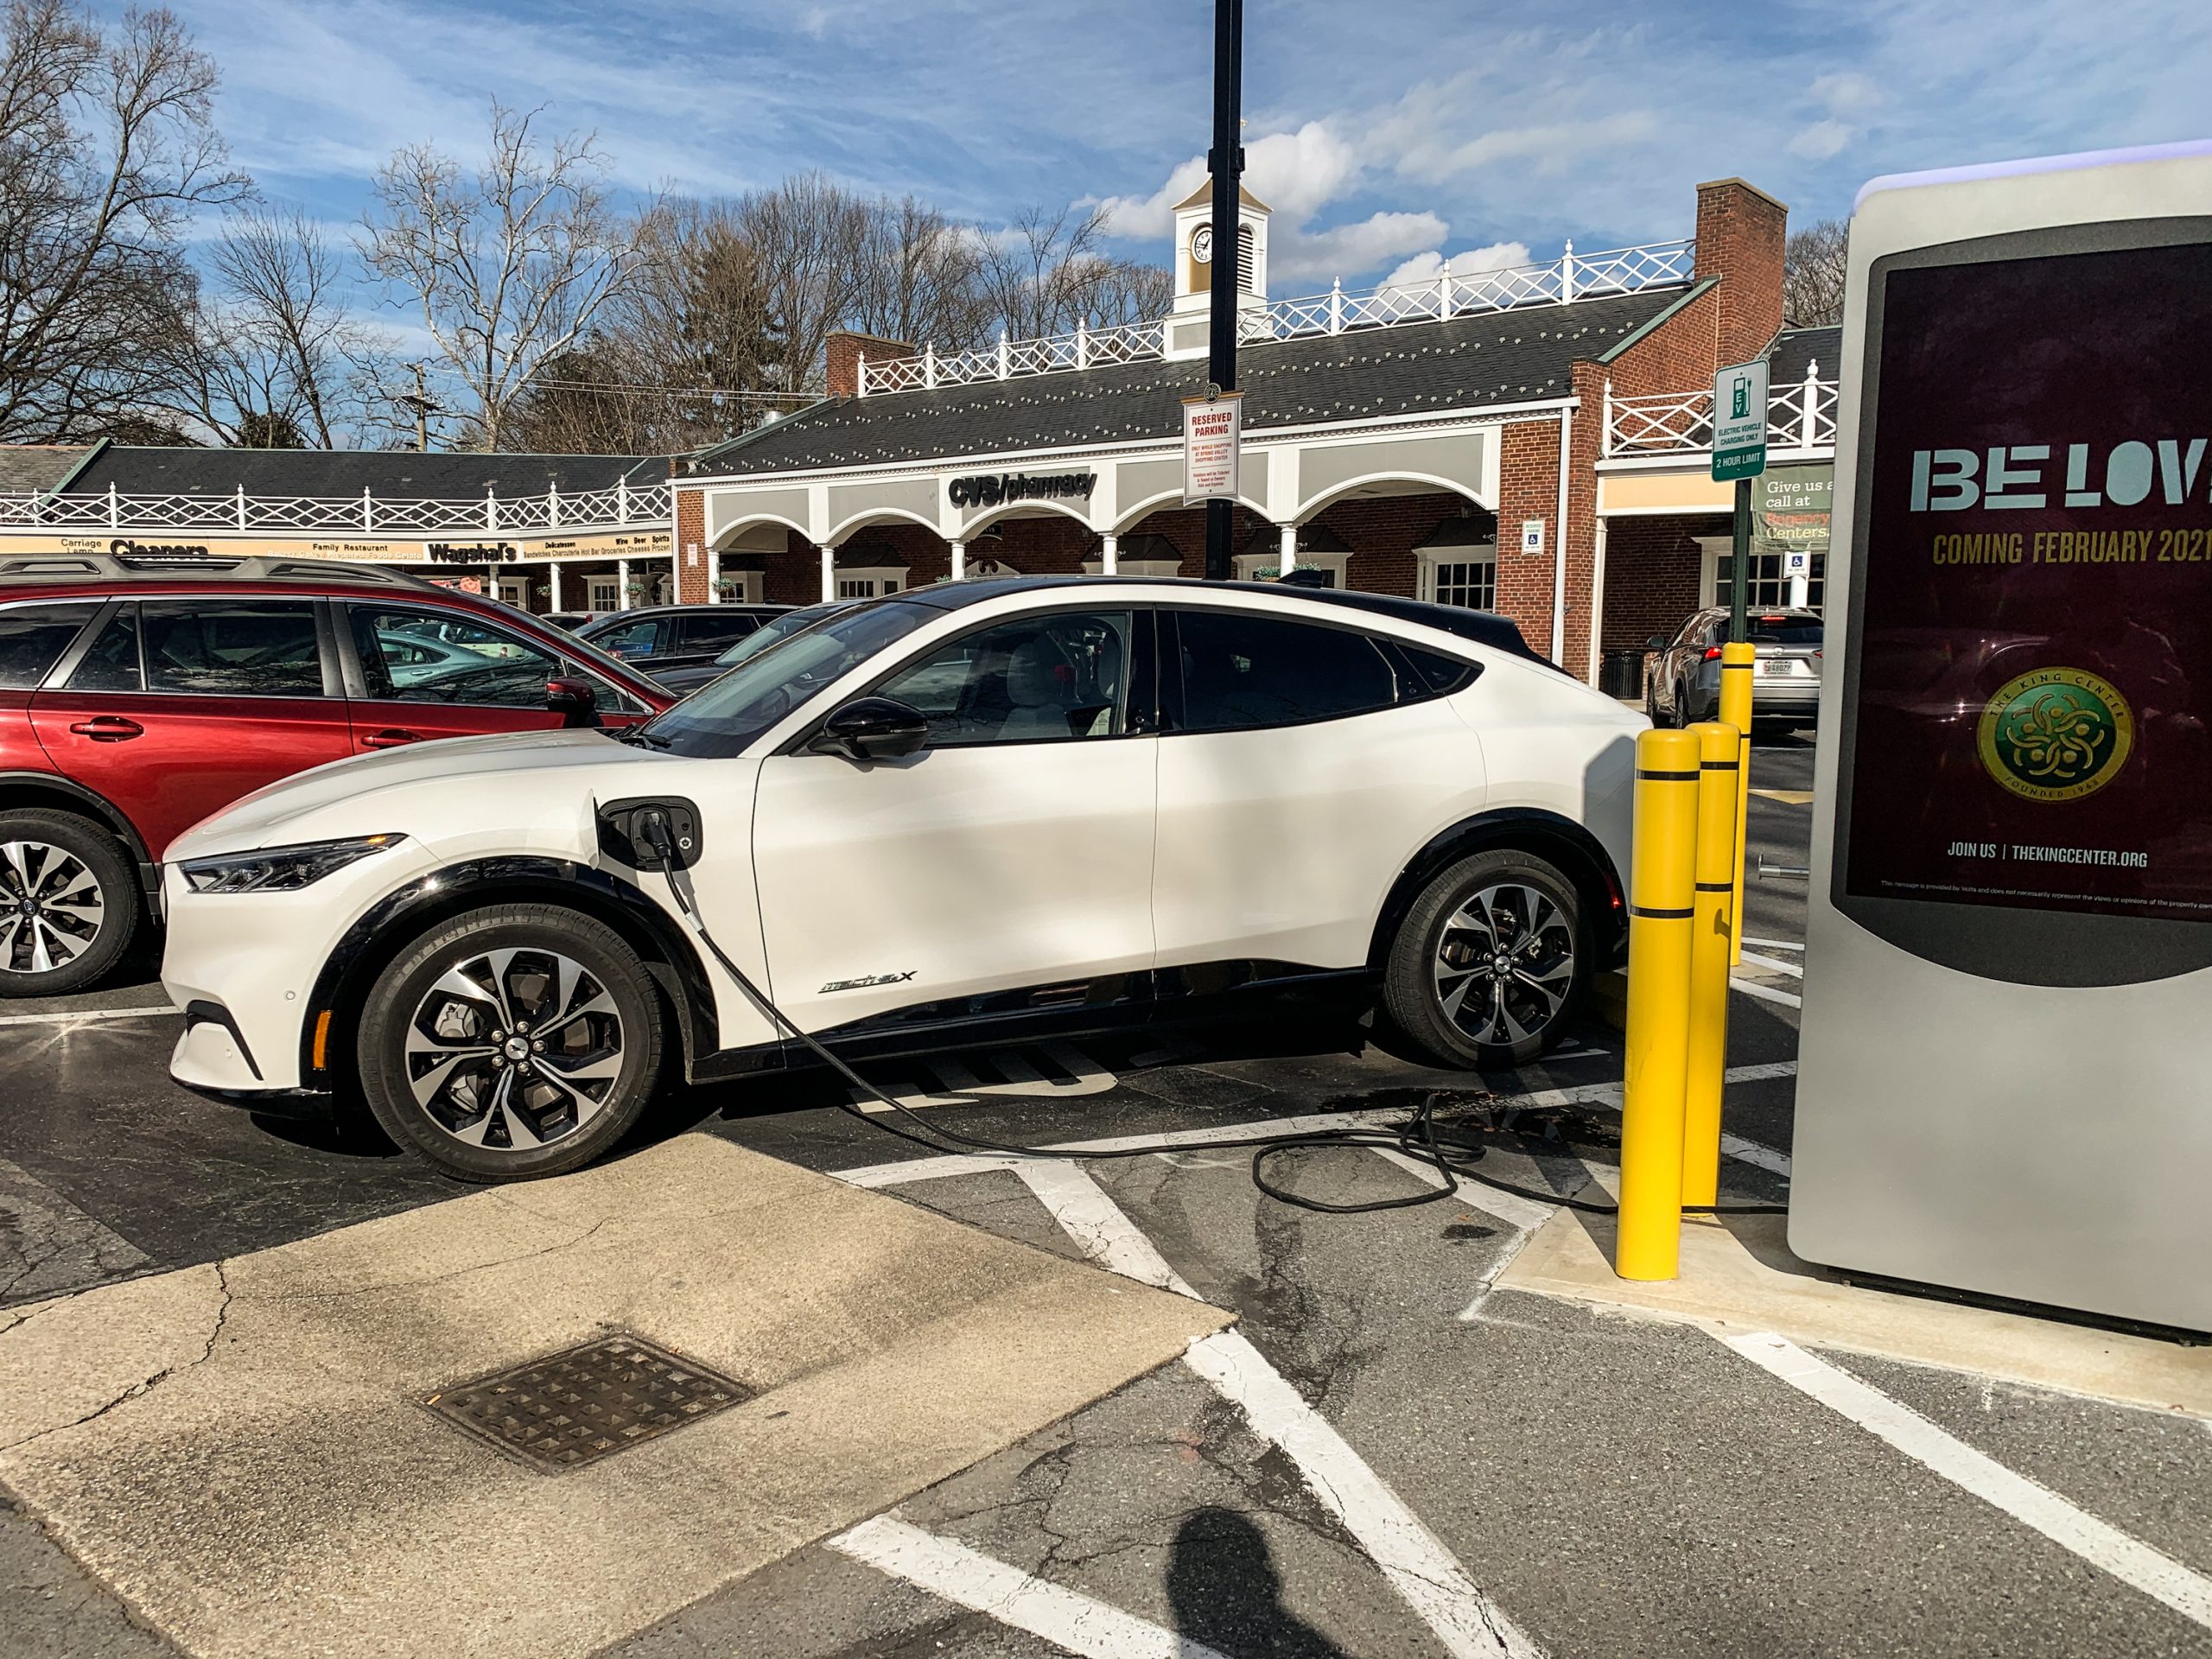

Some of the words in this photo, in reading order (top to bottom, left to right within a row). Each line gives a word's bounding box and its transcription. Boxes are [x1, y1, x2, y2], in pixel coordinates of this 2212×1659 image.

[1192, 412, 1232, 426] RESERVED
[1195, 424, 1229, 437] PARKING
[1719, 427, 1740, 436] ELECTRIC
[1742, 422, 1761, 432] VEHICLE
[1720, 435, 1745, 446] CHARGING
[1745, 433, 1759, 442] ONLY
[1716, 459, 1721, 468] 2
[1723, 455, 1741, 467] HOUR
[1742, 452, 1761, 465] LIMIT
[1910, 445, 2050, 512] BE
[2065, 438, 2212, 507] LOV
[1767, 481, 1801, 493] Give
[1805, 482, 1823, 492] us
[1766, 495, 1791, 508] call
[1796, 496, 1810, 506] at
[1766, 512, 1830, 526] Regency
[1766, 527, 1830, 539] Centers.
[60, 539, 102, 550] Carriage
[313, 543, 339, 553] Family
[545, 541, 575, 550] Delicatessen
[615, 537, 628, 546] Wine
[652, 535, 670, 543] Spirits
[1933, 532, 2023, 565] COMING
[2032, 529, 2153, 563] FEBRUARY
[2158, 529, 2212, 562] 2021
[428, 543, 517, 563] Wagshal's
[524, 550, 551, 558] Sandwiches
[551, 550, 580, 558] Charcuterie
[601, 546, 626, 555] Groceries
[627, 544, 651, 553] Cheeses
[652, 543, 671, 552] Frozen
[1989, 692, 2012, 717] THE
[2020, 673, 2062, 690] KING
[2075, 677, 2124, 719] CENTER
[2005, 776, 2063, 798] FOUNDED
[2074, 779, 2100, 795] 1968
[1948, 842, 1977, 857] JOIN
[1980, 843, 1997, 858] US
[2012, 845, 2148, 868] THEKINGCENTER.ORG
[2017, 890, 2050, 899] necessarily
[2051, 892, 2081, 900] represent
[2120, 897, 2148, 906] opinions
[2169, 900, 2197, 909] property
